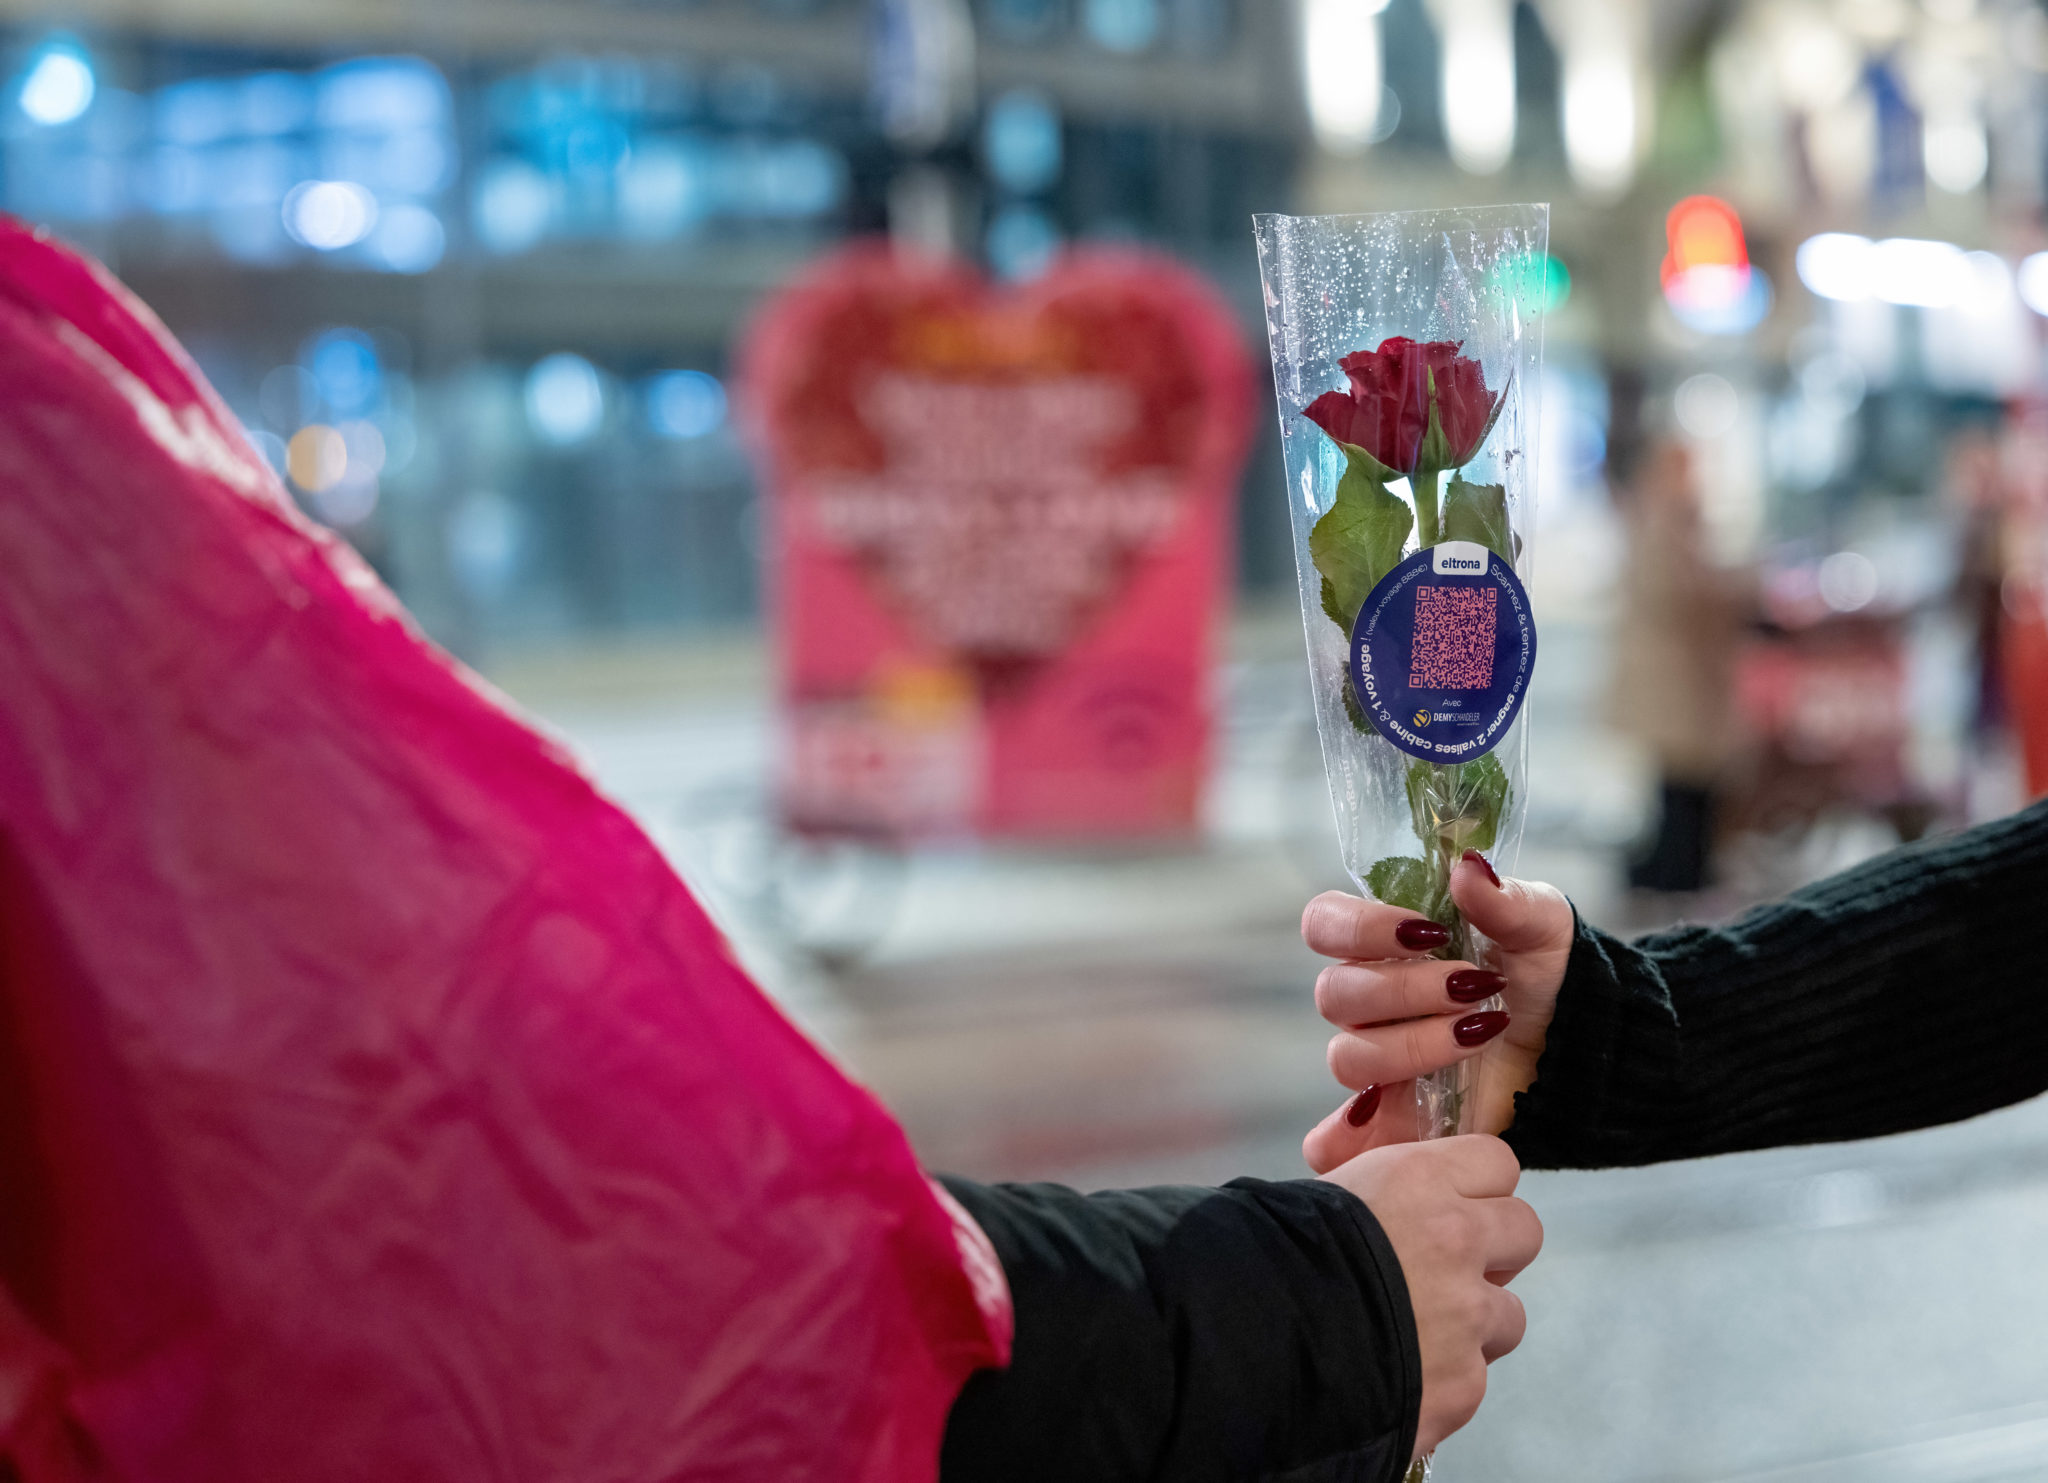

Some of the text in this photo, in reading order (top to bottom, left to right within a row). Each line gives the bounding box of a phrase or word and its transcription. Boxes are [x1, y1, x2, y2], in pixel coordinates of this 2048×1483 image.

[1441, 557, 1480, 569] eltrona
[1378, 582, 1402, 607] voyage
[1490, 564, 1522, 612] Scannez
[1518, 614, 1527, 625] &
[1519, 627, 1530, 673] tentez
[1360, 644, 1378, 700] voyage
[1512, 675, 1523, 693] de
[1371, 700, 1382, 711] 1
[1442, 698, 1462, 707] Avec
[1379, 708, 1391, 721] &
[1487, 693, 1515, 737] gagner
[1389, 720, 1432, 749] cabine
[1476, 733, 1486, 745] 2
[1435, 740, 1477, 755] valises
